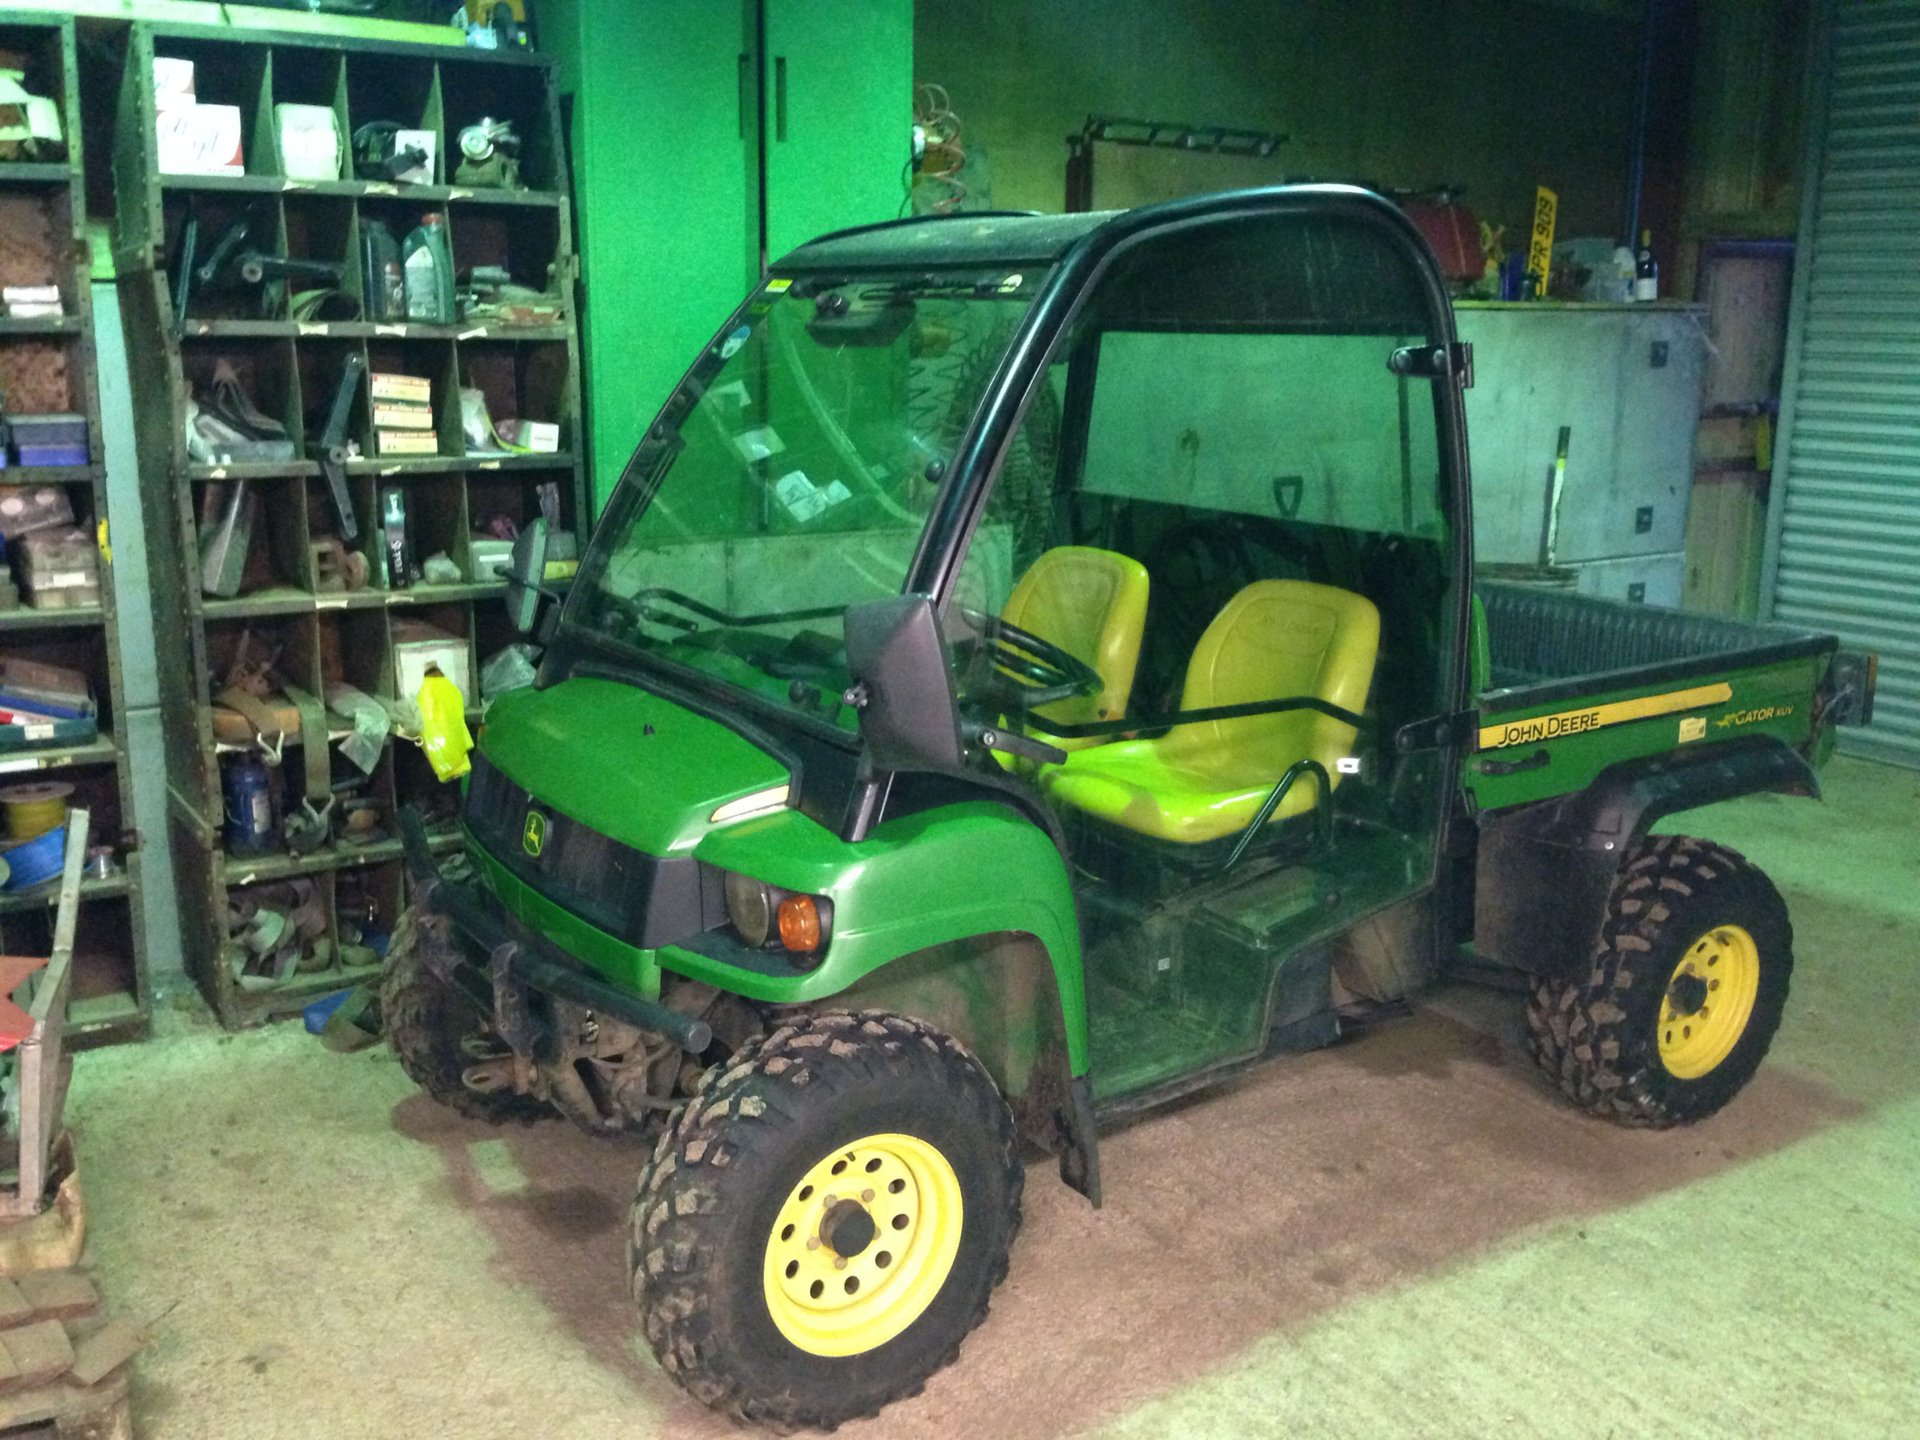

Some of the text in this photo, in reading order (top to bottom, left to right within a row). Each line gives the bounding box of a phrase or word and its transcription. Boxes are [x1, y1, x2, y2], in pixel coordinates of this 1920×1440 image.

[1536, 196, 1553, 239] 909
[1498, 712, 1600, 746] JOHN DEERE
[1735, 707, 1775, 725] GATOR
